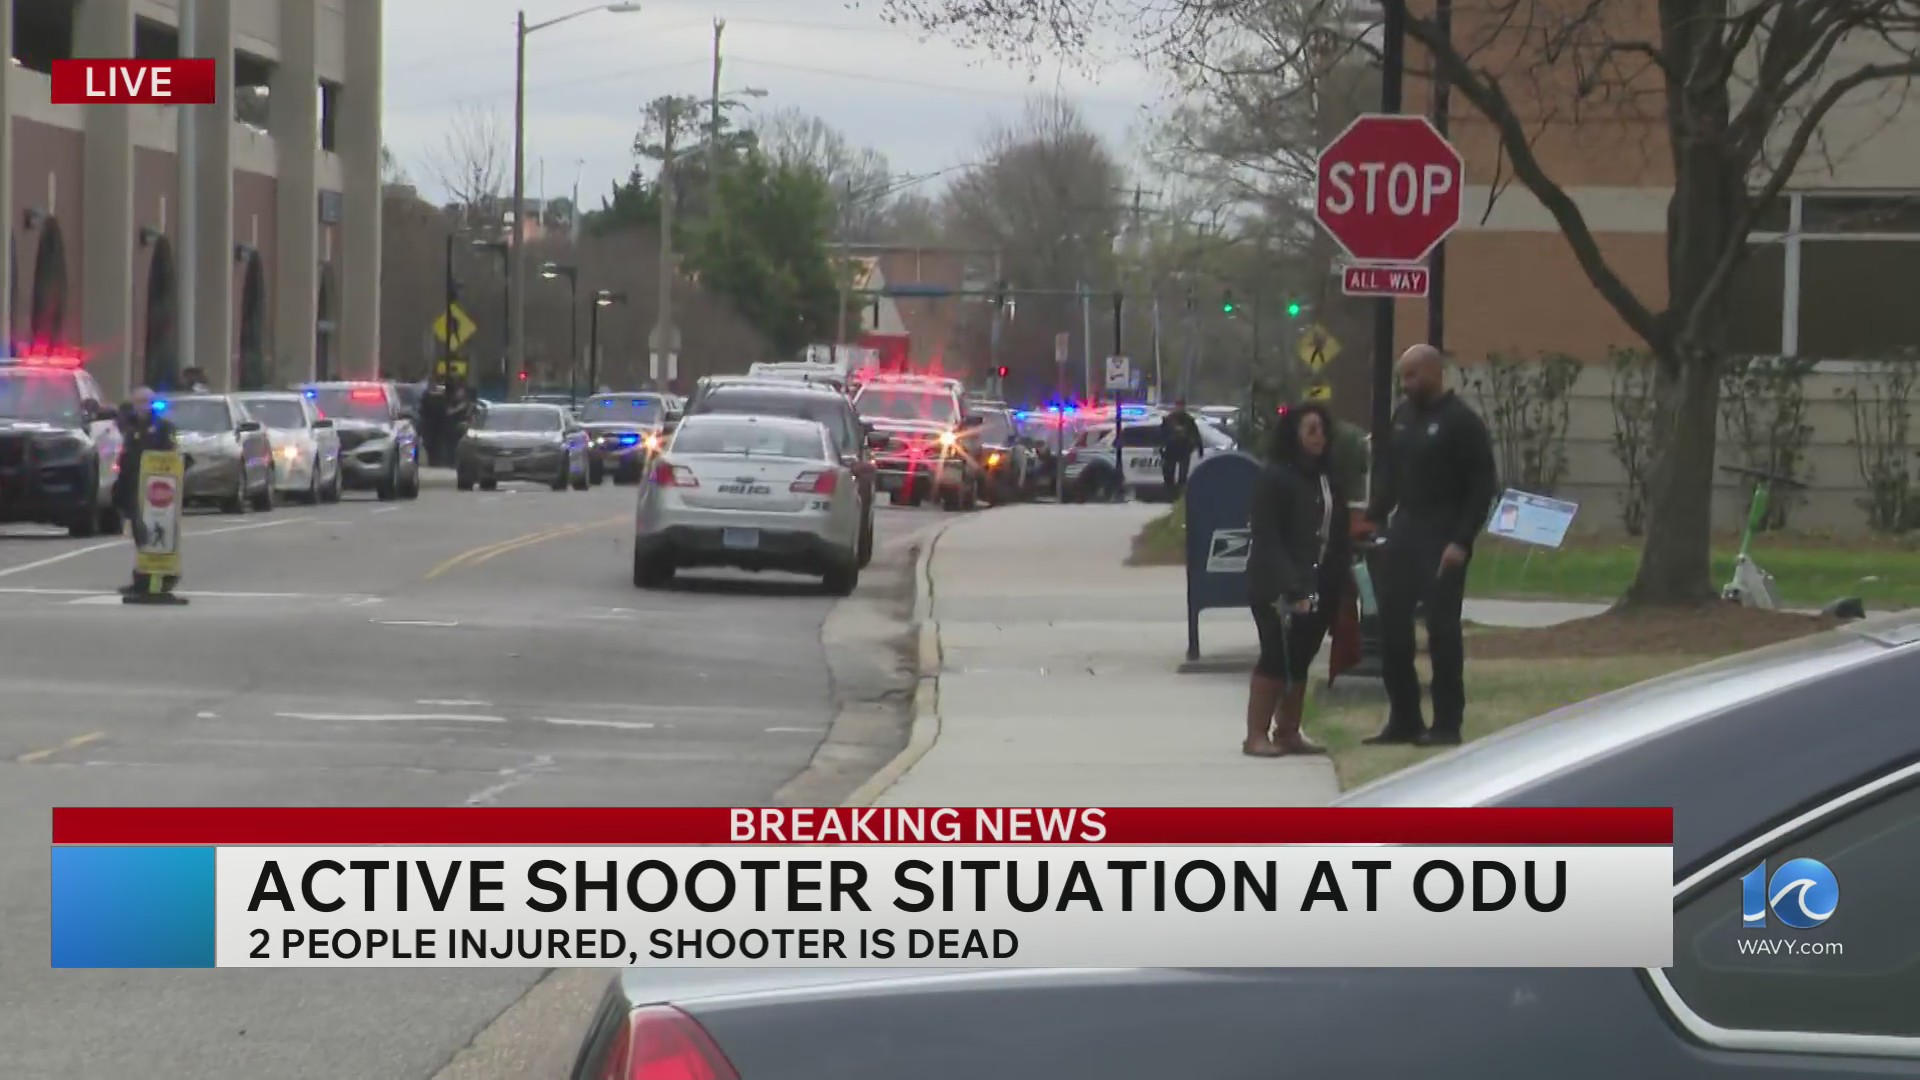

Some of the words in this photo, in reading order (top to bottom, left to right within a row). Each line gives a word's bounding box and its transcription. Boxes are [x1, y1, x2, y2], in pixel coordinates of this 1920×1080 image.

[1325, 161, 1453, 216] STOP
[1350, 271, 1379, 289] ALL
[1389, 272, 1422, 290] WAY
